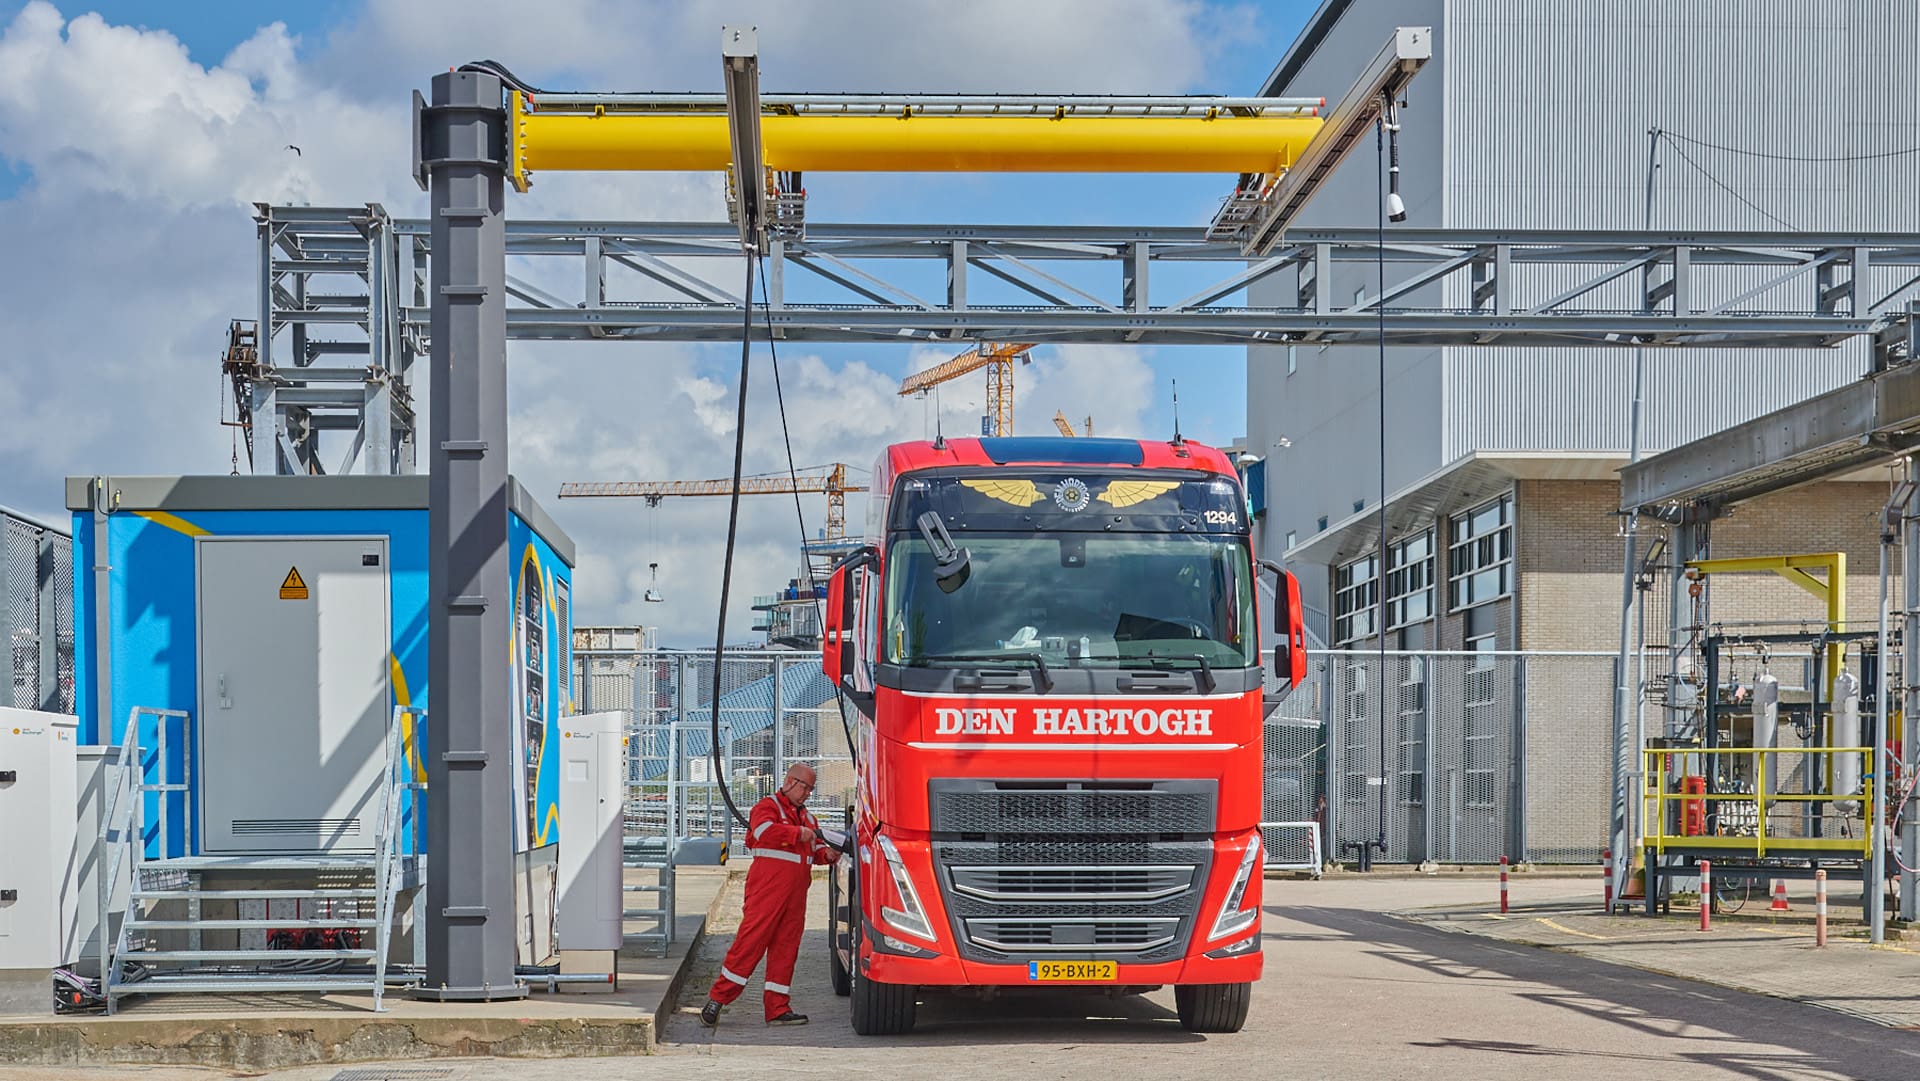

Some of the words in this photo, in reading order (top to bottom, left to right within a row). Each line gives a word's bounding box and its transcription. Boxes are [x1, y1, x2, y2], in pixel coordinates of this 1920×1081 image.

[1203, 510, 1237, 525] 1294
[935, 708, 1017, 735] DEN
[1032, 708, 1213, 736] HARTOGH
[1041, 964, 1111, 978] 95-BXH-2
